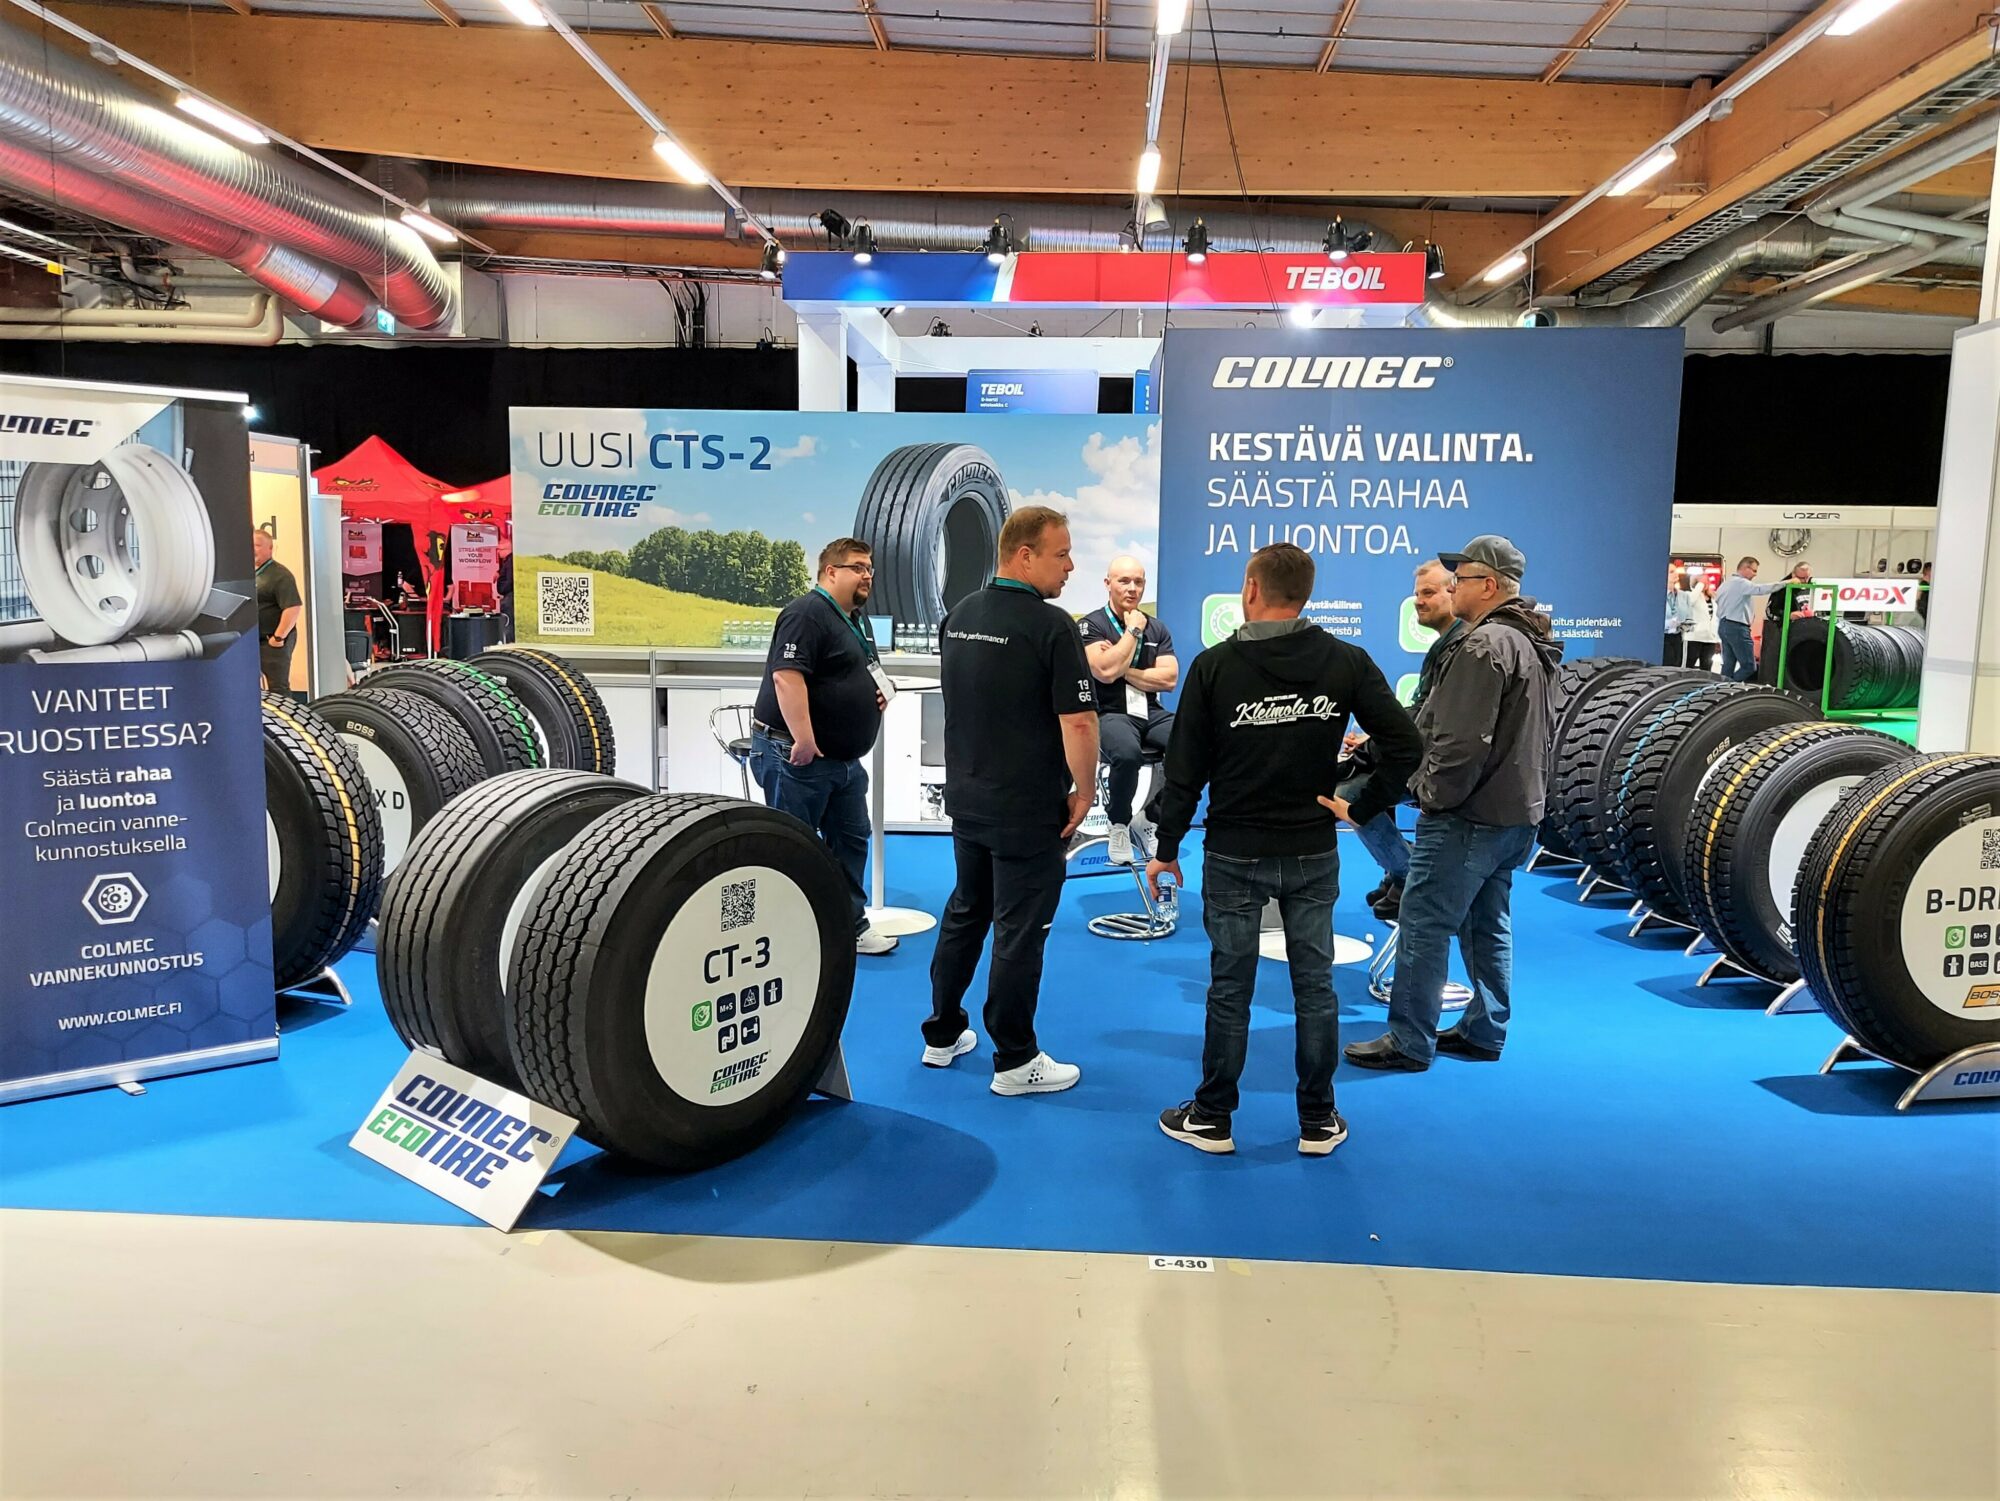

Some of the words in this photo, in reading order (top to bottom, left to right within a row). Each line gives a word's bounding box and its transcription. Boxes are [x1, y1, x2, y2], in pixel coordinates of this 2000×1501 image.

[1285, 266, 1386, 290] TEBOIL
[980, 383, 1024, 396] TEBOIL
[538, 431, 633, 469] UUSI
[650, 433, 772, 471] CTS-2
[1209, 425, 1365, 462] KESTÄVÄ
[1375, 432, 1534, 463] VALINTA.
[542, 483, 657, 502] COLMEC
[1207, 470, 1337, 508] SÄÄSTÄ
[1350, 478, 1470, 509] RAHAA
[1204, 523, 1239, 556] JA
[1249, 523, 1420, 555] LUONTOA.
[1350, 616, 1362, 624] on
[1576, 617, 1622, 628] pidentävät
[1561, 629, 1604, 638] säästävät
[785, 643, 797, 651] 19
[1077, 679, 1089, 690] 19
[31, 686, 174, 714] VANTEET
[1078, 691, 1092, 703] 66
[1230, 698, 1309, 728] Kleimola
[1312, 695, 1340, 720] Oy
[0, 722, 213, 755] RUOSTEESSA?
[346, 720, 376, 738] BOSS
[42, 768, 112, 788] Säästä
[116, 765, 173, 783] rahaa
[56, 795, 75, 816] ja
[79, 791, 157, 810] luontoa
[24, 816, 116, 838] Colmecin
[121, 813, 188, 831] vanne-
[35, 834, 187, 862] kunnostuksella
[1925, 886, 2000, 914] B-DR
[1973, 932, 1988, 940] M+S
[81, 938, 155, 960] COLMEC
[703, 936, 771, 985] CT-3
[29, 952, 204, 987] VANNEKUNNOSTUS
[1969, 960, 1988, 969] BASE
[57, 1002, 183, 1031] WWW.COLMEC.FI
[719, 1002, 733, 1013] M+S
[712, 1051, 769, 1083] COLMEC
[366, 1108, 509, 1190] ECOTIRE
[1154, 1258, 1208, 1269] C-430
